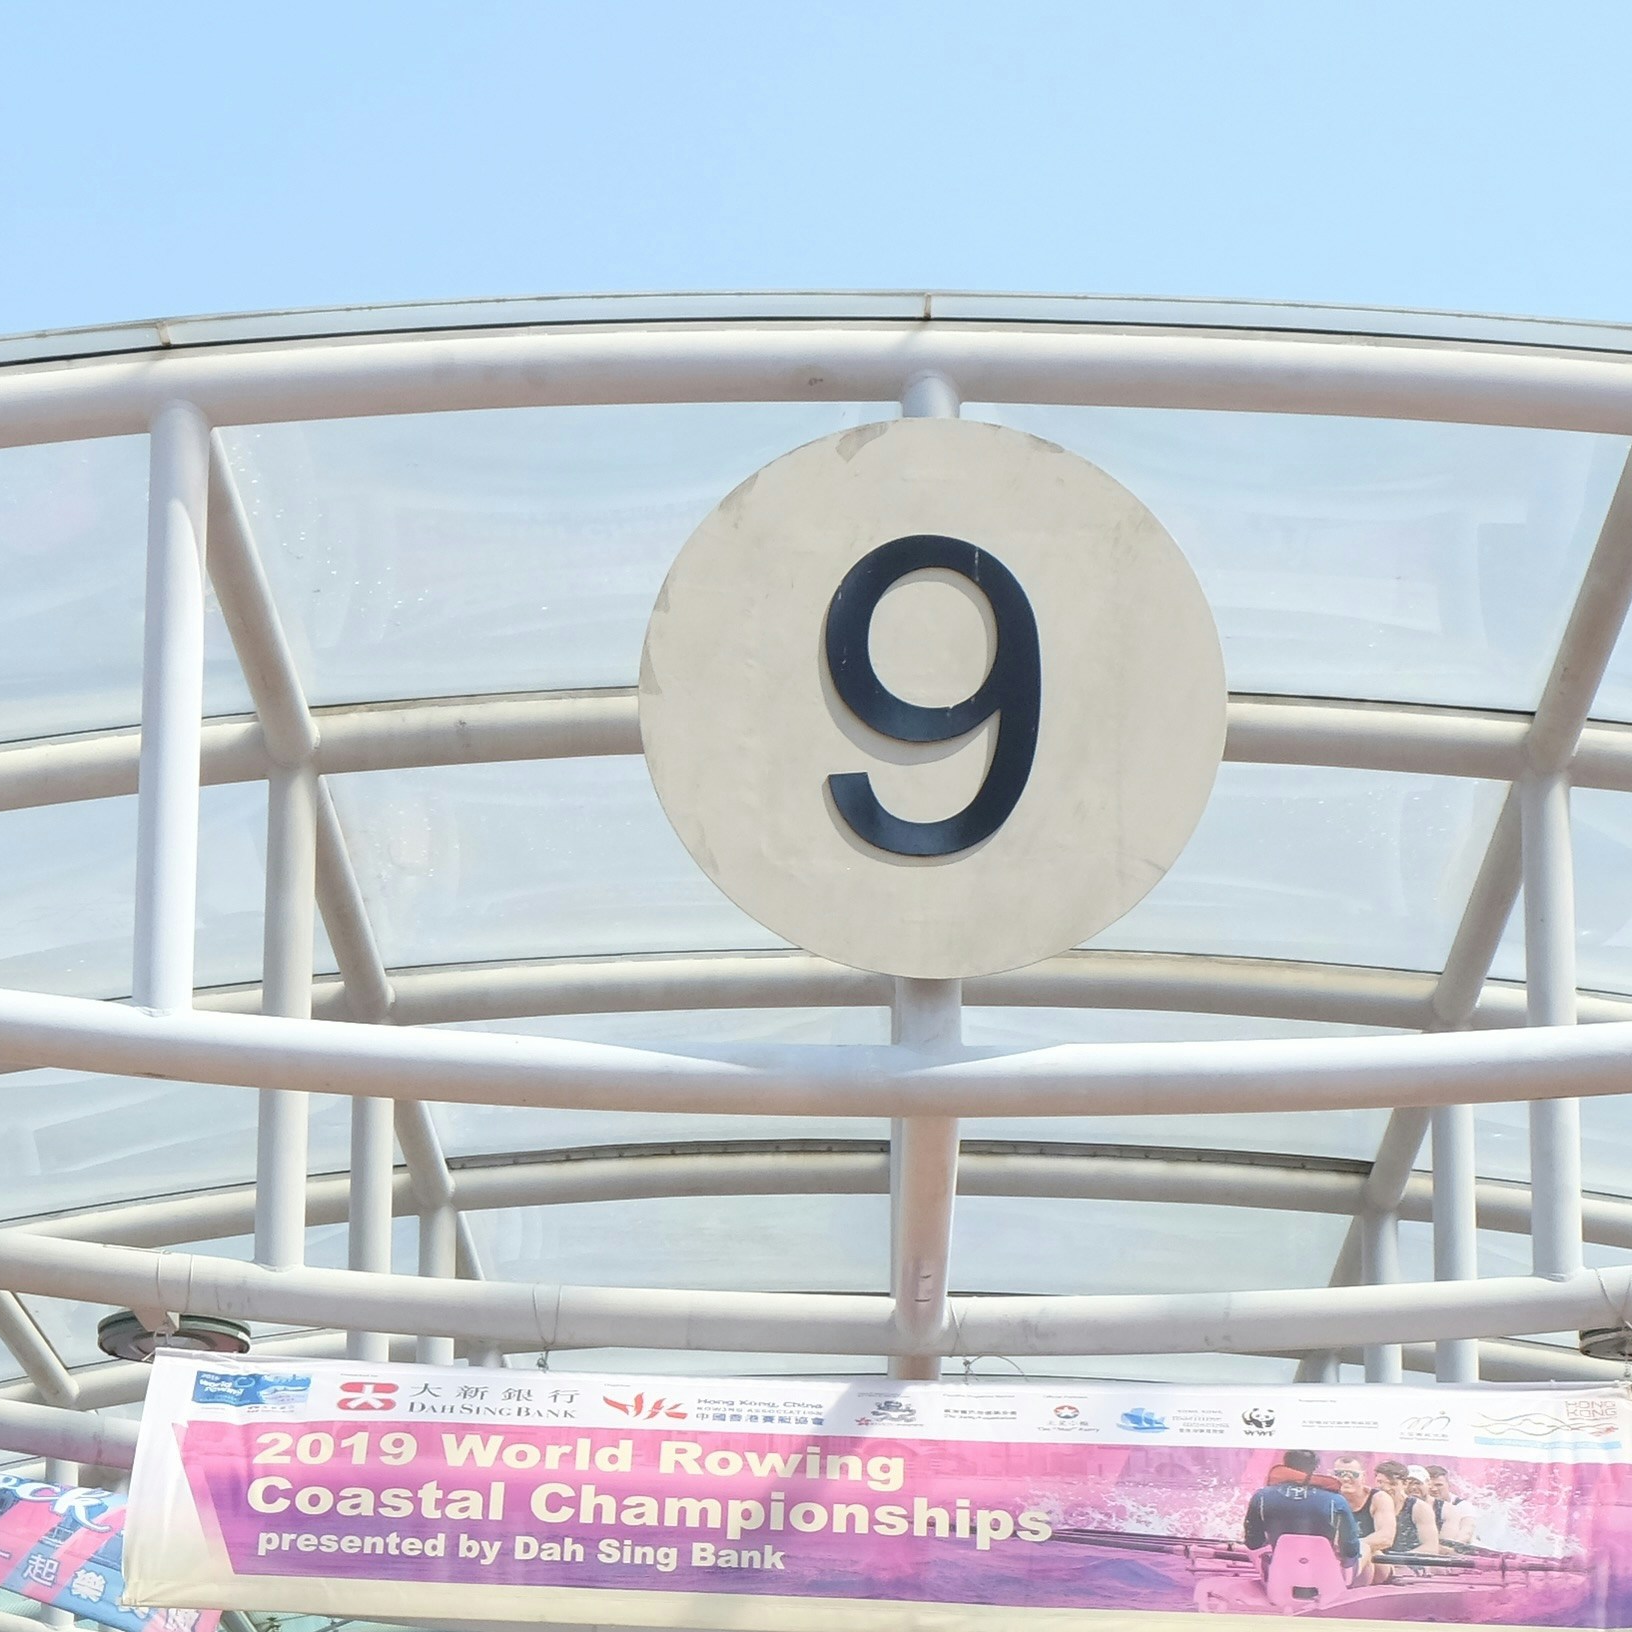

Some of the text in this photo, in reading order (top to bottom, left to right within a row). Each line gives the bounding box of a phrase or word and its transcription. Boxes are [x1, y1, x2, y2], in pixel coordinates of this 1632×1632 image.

[824, 534, 1041, 856] 9
[408, 1402, 576, 1419] DAH SING BANK
[409, 1383, 580, 1404] 大新銀行
[252, 1431, 905, 1492] 2019 World Rowing
[247, 1476, 1053, 1551] Coastal Championships
[257, 1530, 786, 1572] presented by Dah Sing Bank
